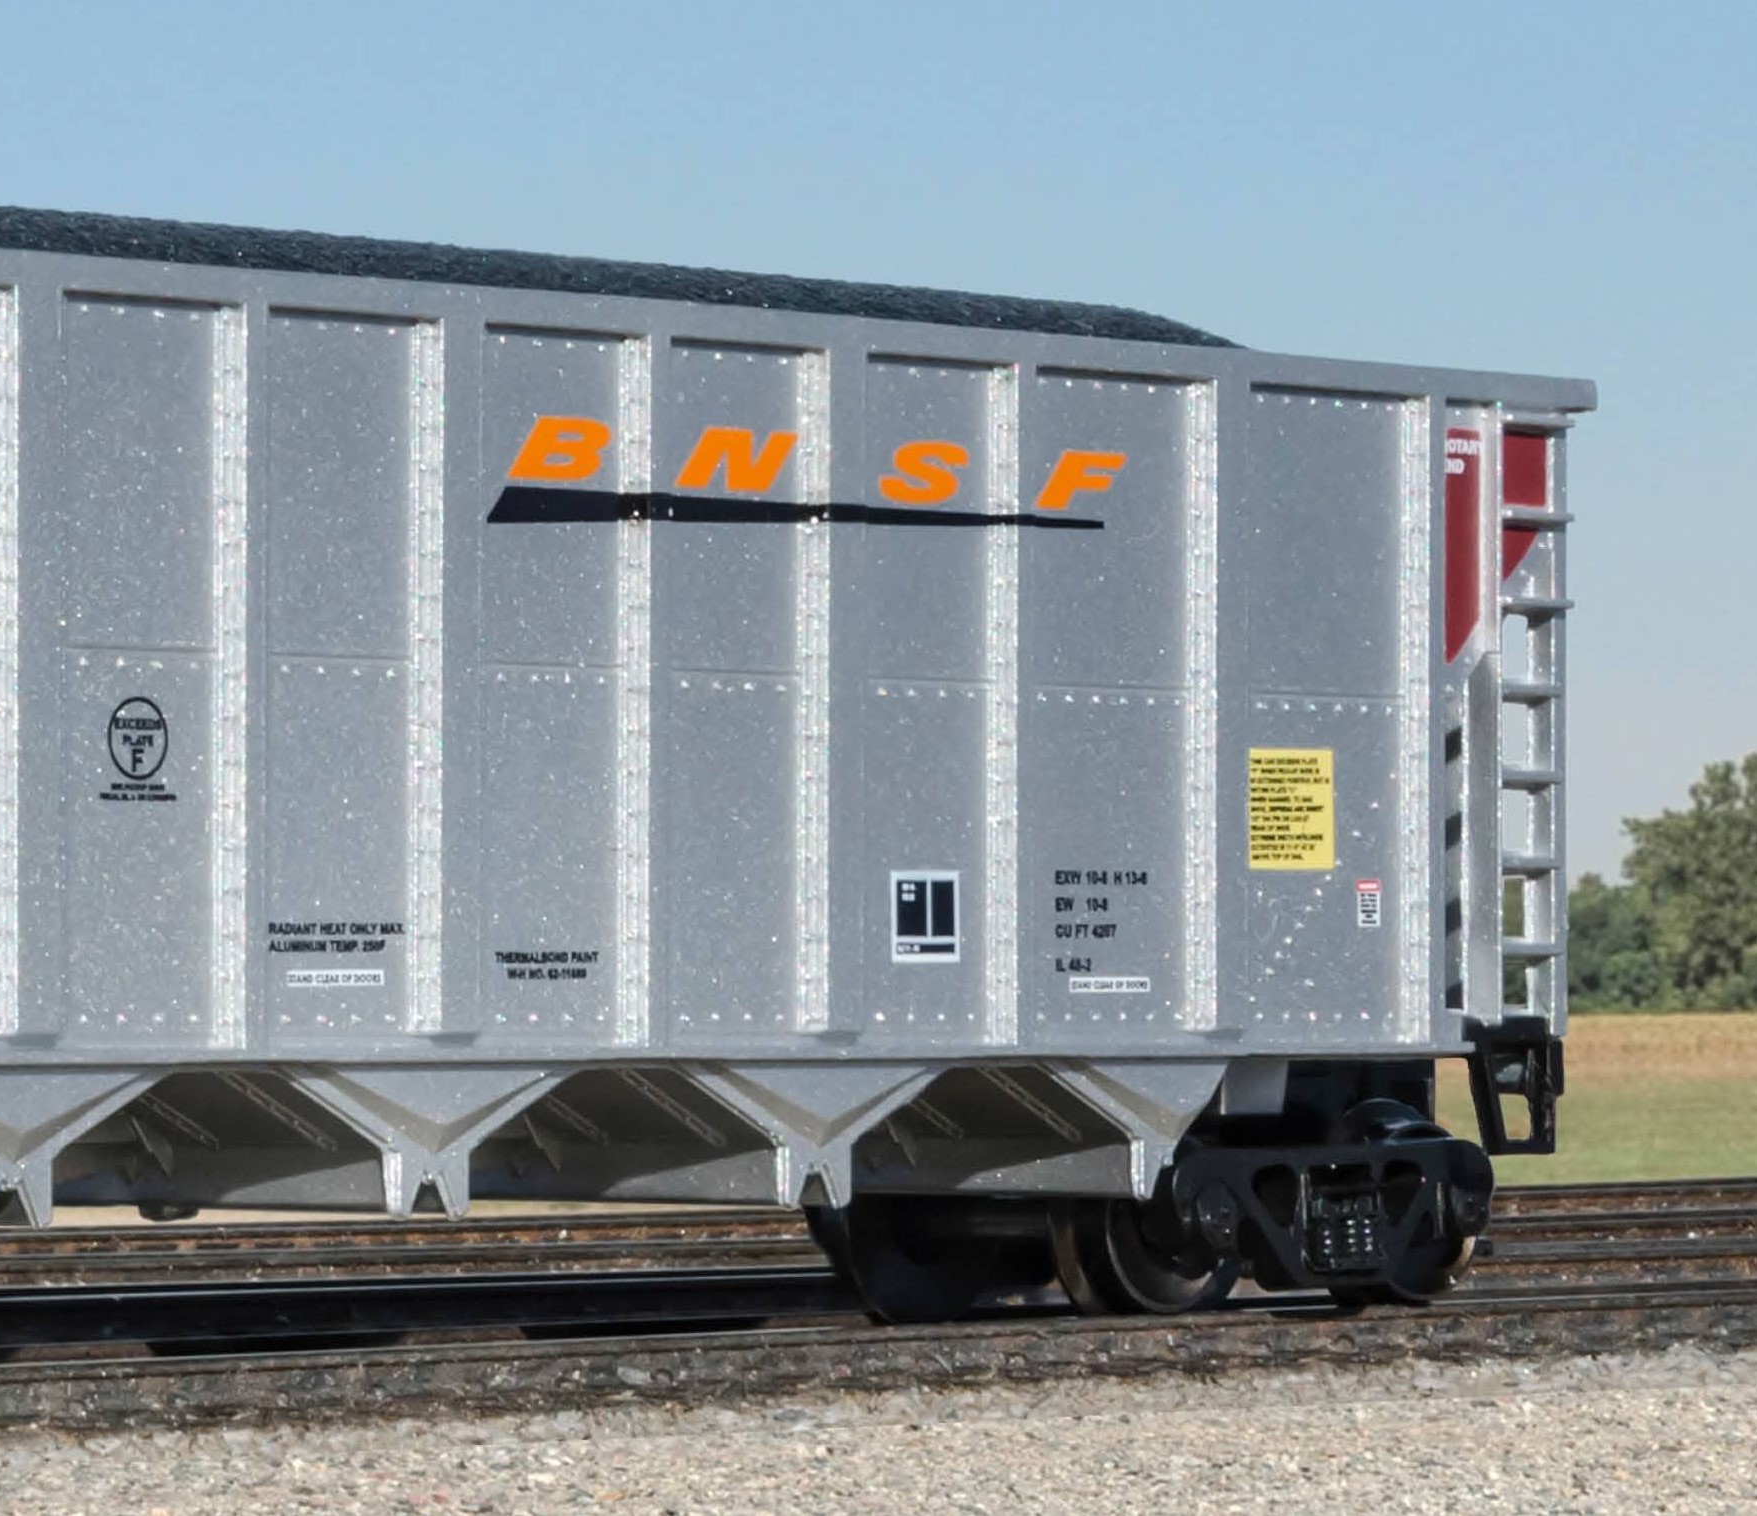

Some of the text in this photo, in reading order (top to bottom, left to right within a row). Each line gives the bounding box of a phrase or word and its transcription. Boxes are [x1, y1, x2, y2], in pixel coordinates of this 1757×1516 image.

[131, 748, 144, 772] F
[1055, 897, 1074, 912] EW
[268, 923, 317, 935] RADIANT
[1055, 924, 1072, 938] CU
[1075, 924, 1088, 938] FT
